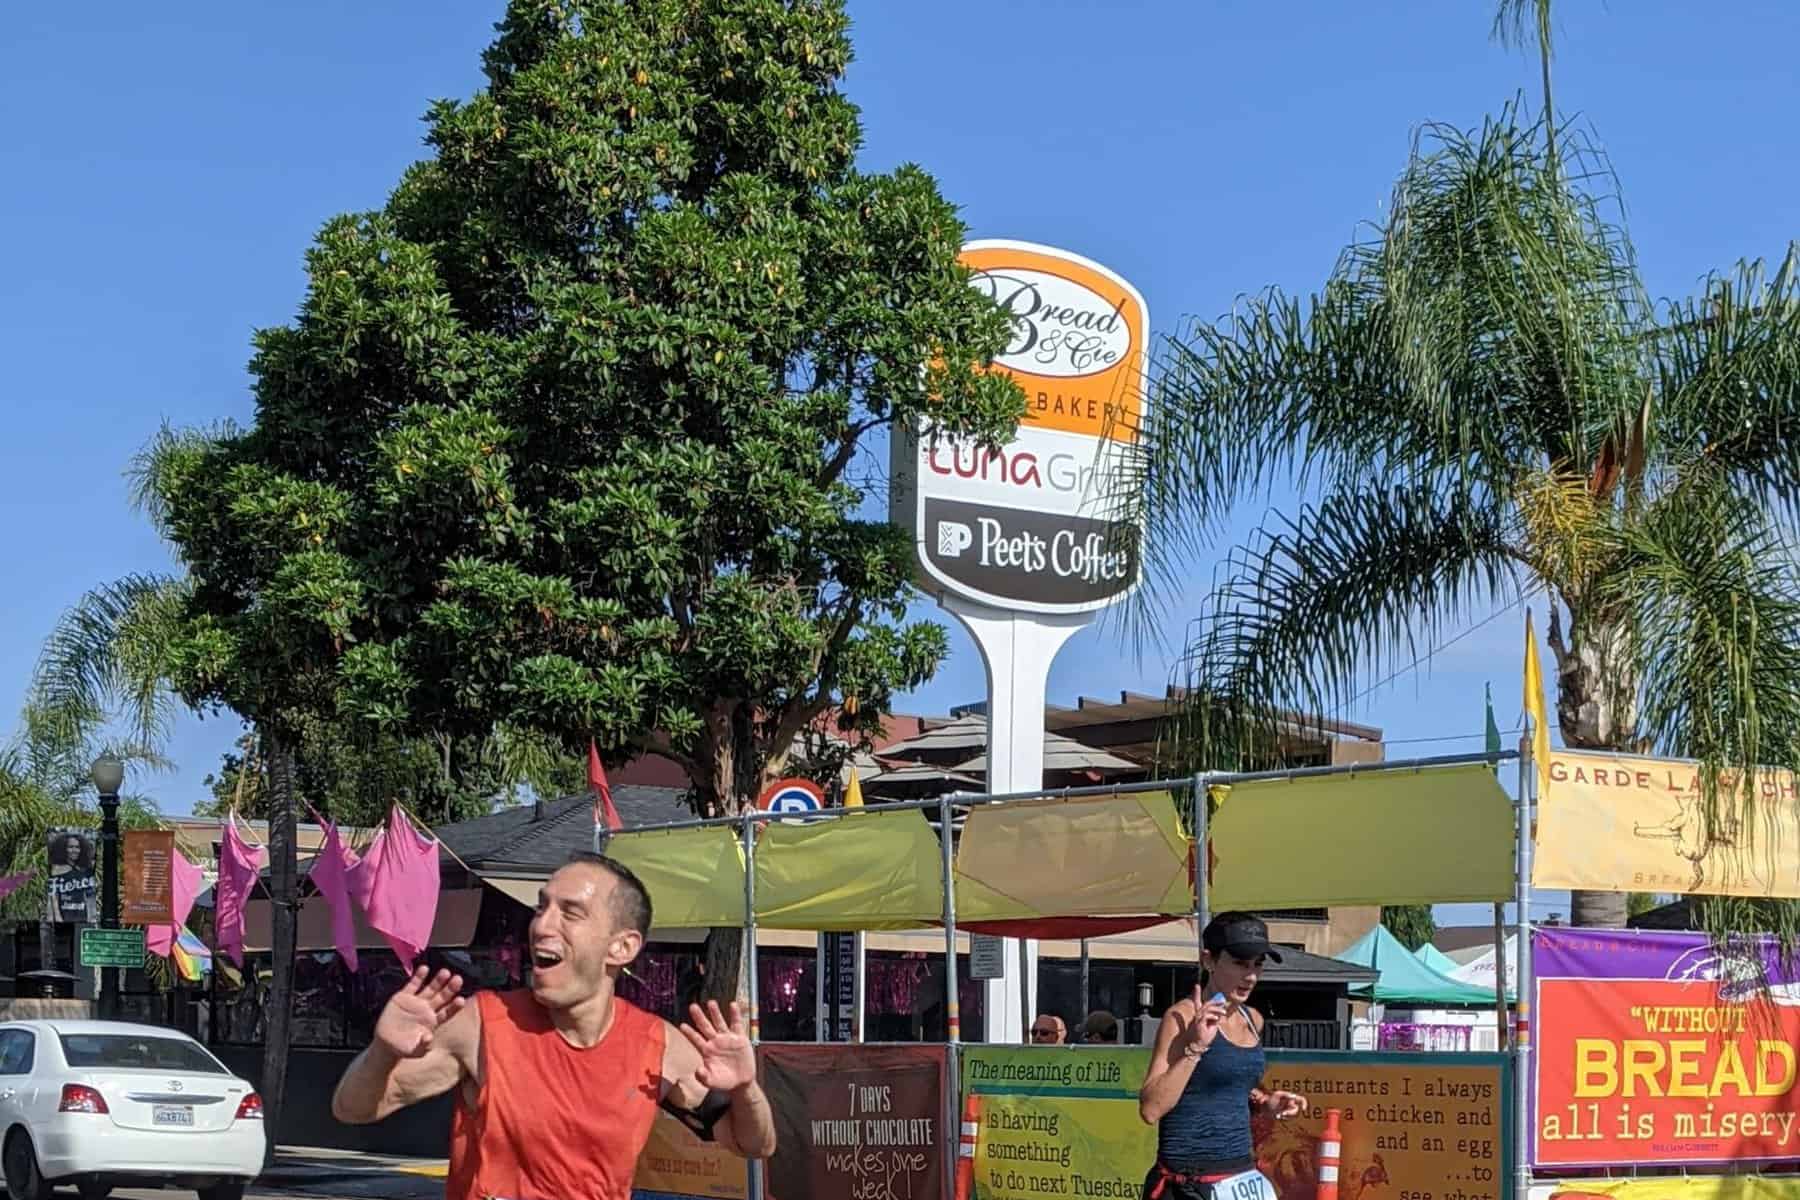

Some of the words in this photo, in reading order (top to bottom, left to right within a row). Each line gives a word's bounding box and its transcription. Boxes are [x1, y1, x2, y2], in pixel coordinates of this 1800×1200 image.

[968, 271, 1127, 356] Bread
[1034, 329, 1065, 365] &
[1064, 331, 1118, 374] Cie
[1036, 391, 1130, 424] BAKERY
[977, 516, 1046, 573] Peet's
[1051, 529, 1129, 585] Coffee
[1549, 760, 1651, 789] GARDE
[1667, 770, 1704, 793] LA
[1631, 1006, 1746, 1034] “WITHOUT
[970, 1059, 998, 1080] The
[1001, 1061, 1073, 1086] meaning
[1076, 1061, 1095, 1083] of
[1096, 1062, 1121, 1084] life
[1573, 1038, 1798, 1100] BREAD
[848, 1082, 856, 1118] 7
[860, 1084, 892, 1113] DAYS
[1271, 1077, 1390, 1097] restaurants
[1401, 1078, 1413, 1097] I
[1424, 1078, 1493, 1103] always
[811, 1119, 862, 1147] WITHOUT
[865, 1118, 935, 1146] CHOCOLATE
[986, 1108, 999, 1130] is
[1002, 1104, 1060, 1137] having
[1344, 1107, 1355, 1121] a
[1366, 1105, 1446, 1125] chicken
[1456, 1106, 1492, 1127] and
[1542, 1103, 1604, 1140] all
[1616, 1103, 1655, 1139] is
[826, 1142, 886, 1177] makes
[891, 1151, 928, 1173] one
[987, 1141, 1072, 1169] something
[1376, 1132, 1409, 1151] and
[1421, 1137, 1445, 1151] an
[1456, 1138, 1494, 1159] egg
[990, 1168, 1002, 1189] to
[1007, 1169, 1026, 1191] do
[1029, 1171, 1068, 1195] next
